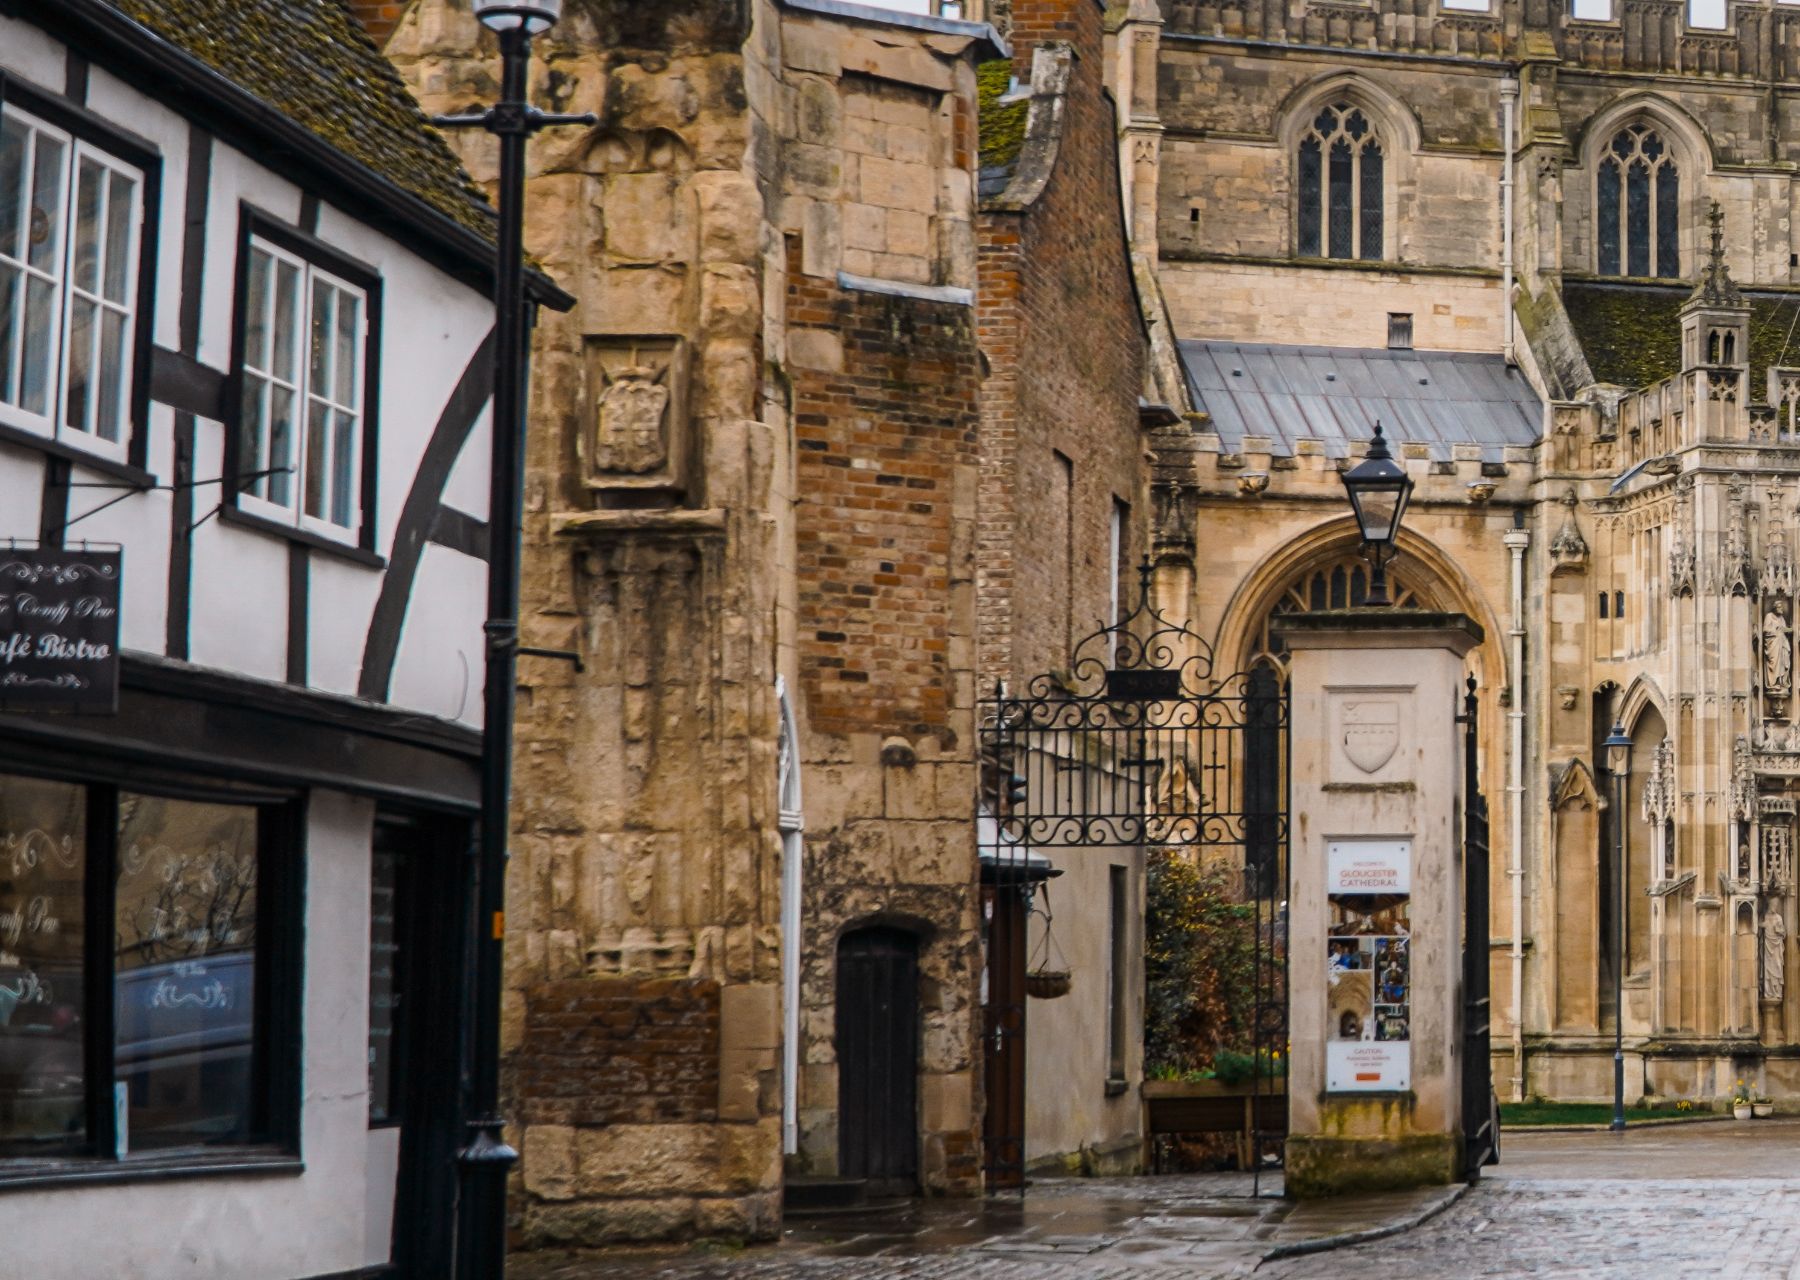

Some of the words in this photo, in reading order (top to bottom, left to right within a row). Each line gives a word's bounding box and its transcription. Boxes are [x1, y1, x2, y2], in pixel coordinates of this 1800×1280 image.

[15, 593, 70, 624] Comfy
[0, 633, 32, 664] afé
[36, 634, 111, 659] Bistro
[1340, 869, 1398, 878] GLOUCESTER
[1340, 879, 1399, 887] CATHEDRAL
